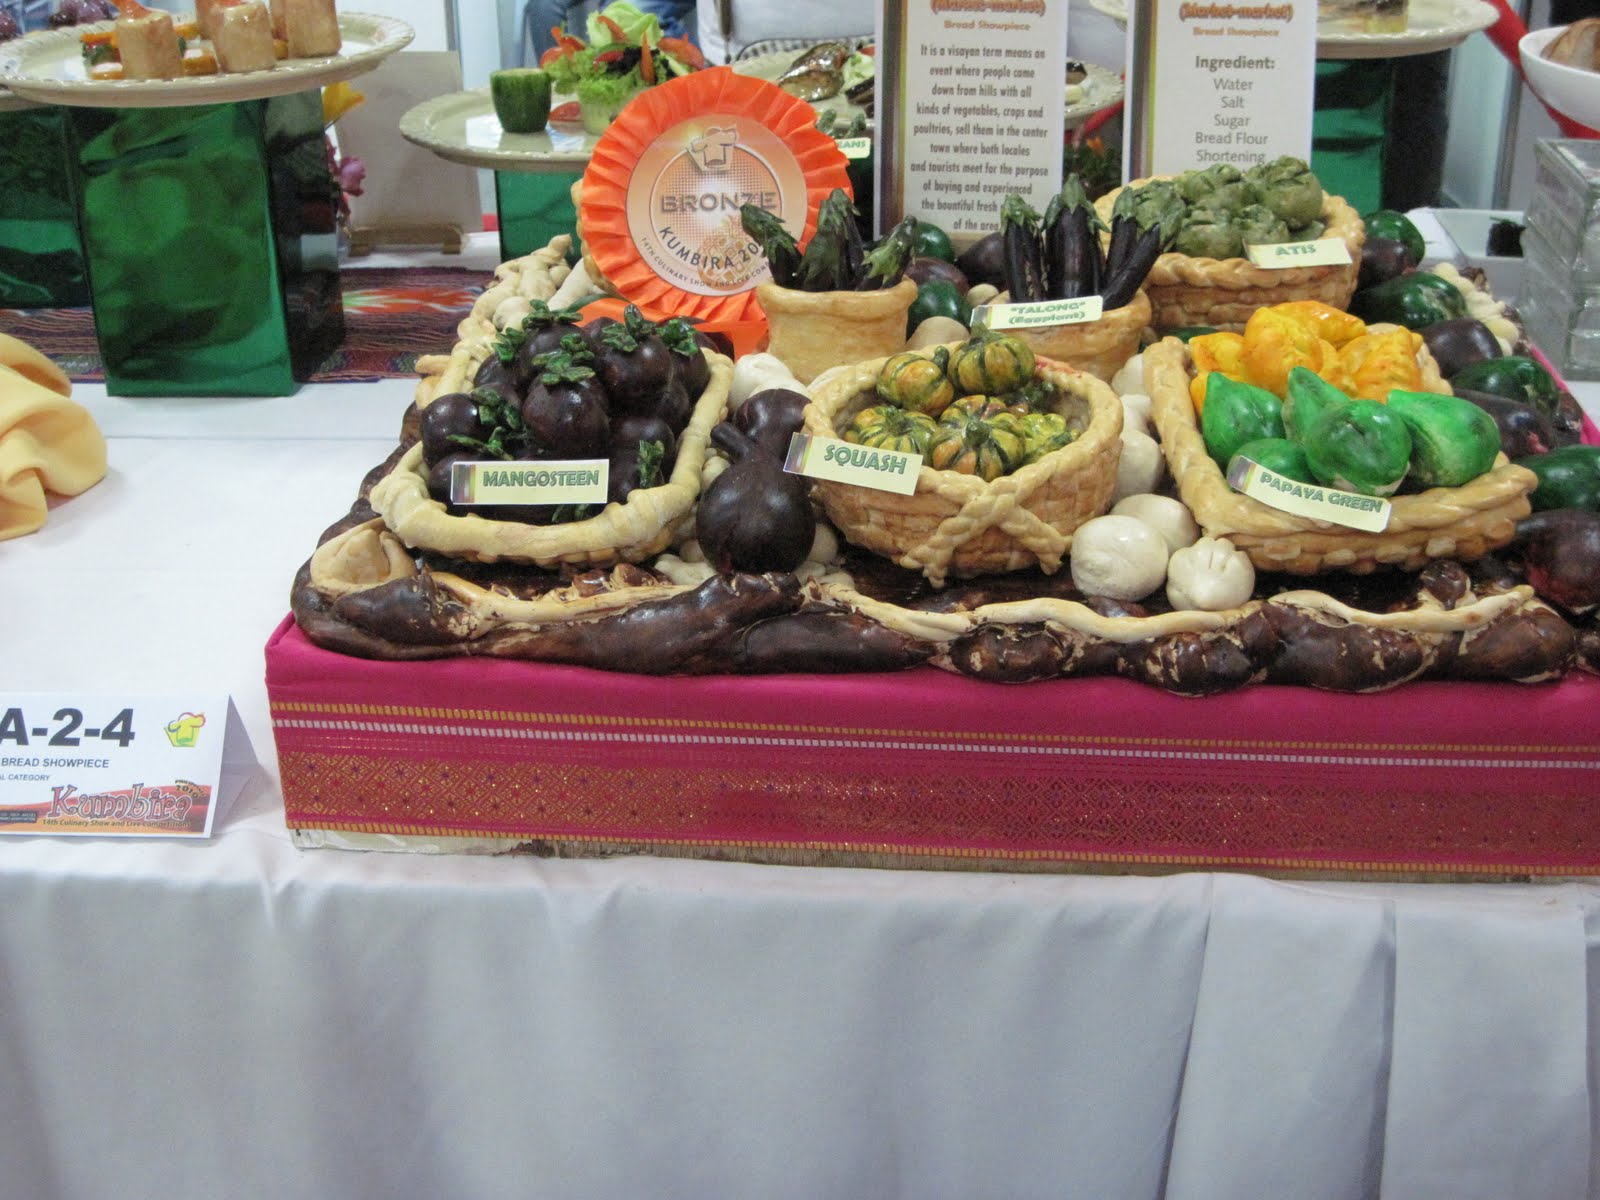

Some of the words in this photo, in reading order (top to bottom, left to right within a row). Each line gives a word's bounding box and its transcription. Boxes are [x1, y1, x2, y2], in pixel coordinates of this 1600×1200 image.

[944, 20, 975, 30] Bread
[978, 21, 1031, 32] Showpiece
[920, 44, 928, 55] It
[930, 45, 937, 56] is
[940, 47, 945, 56] a
[948, 46, 980, 59] visayan
[983, 47, 1002, 58] term
[1005, 49, 1032, 59] means
[1035, 50, 1045, 59] an
[1195, 56, 1275, 71] Ingredient:
[930, 65, 952, 77] event
[955, 66, 980, 77] where
[983, 67, 1011, 82] people
[932, 84, 954, 95] down
[957, 85, 976, 96] from
[979, 86, 997, 96] hills
[1000, 86, 1018, 97] with
[1020, 87, 1032, 98] all
[1213, 78, 1253, 90] Water
[1221, 97, 1244, 108] Salt
[916, 103, 939, 115] kinds
[942, 104, 950, 115] of
[954, 105, 1000, 119] vegetables,
[1003, 108, 1025, 120] crops
[1028, 107, 1043, 118] and
[1214, 114, 1250, 129] Sugar
[913, 124, 953, 136] poultries,
[956, 125, 970, 135] sell
[973, 125, 994, 136] them
[997, 125, 1004, 136] in
[1007, 125, 1019, 136] the
[1022, 127, 1048, 137] center
[1195, 132, 1231, 144] Bread
[1236, 133, 1268, 144] Flour
[930, 143, 950, 154] town
[953, 143, 977, 154] where
[981, 144, 999, 154] both
[1002, 145, 1030, 156] locales
[1196, 150, 1265, 164] Shortening
[910, 162, 926, 172] and
[929, 162, 960, 173] tourists
[963, 164, 982, 173] meet
[985, 163, 997, 174] for
[1000, 164, 1013, 175] the
[1015, 166, 1048, 178] purpose
[923, 180, 932, 191] of
[935, 181, 962, 194] buying
[965, 183, 980, 192] and
[983, 183, 1032, 195] experienced
[661, 192, 777, 213] BRONZE
[922, 200, 934, 209] the
[937, 200, 974, 211] bountiful
[977, 201, 997, 212] fresh
[954, 218, 962, 229] of
[965, 219, 978, 229] the
[659, 226, 734, 269] KUMBIRA
[738, 242, 761, 262] 20
[1275, 244, 1316, 255] ATIS
[654, 256, 688, 282] CULINARY
[1010, 302, 1086, 314] "TALONG"
[824, 445, 908, 474] SQUASH
[483, 471, 598, 487] MANGOSTEEN
[1260, 472, 1323, 502] PAPAYA
[1328, 492, 1383, 513] GREEN
[2, 758, 39, 766] BREAD
[43, 759, 109, 768] SHOWPIECE
[176, 785, 199, 798] 2010
[47, 783, 193, 821] Kumbira
